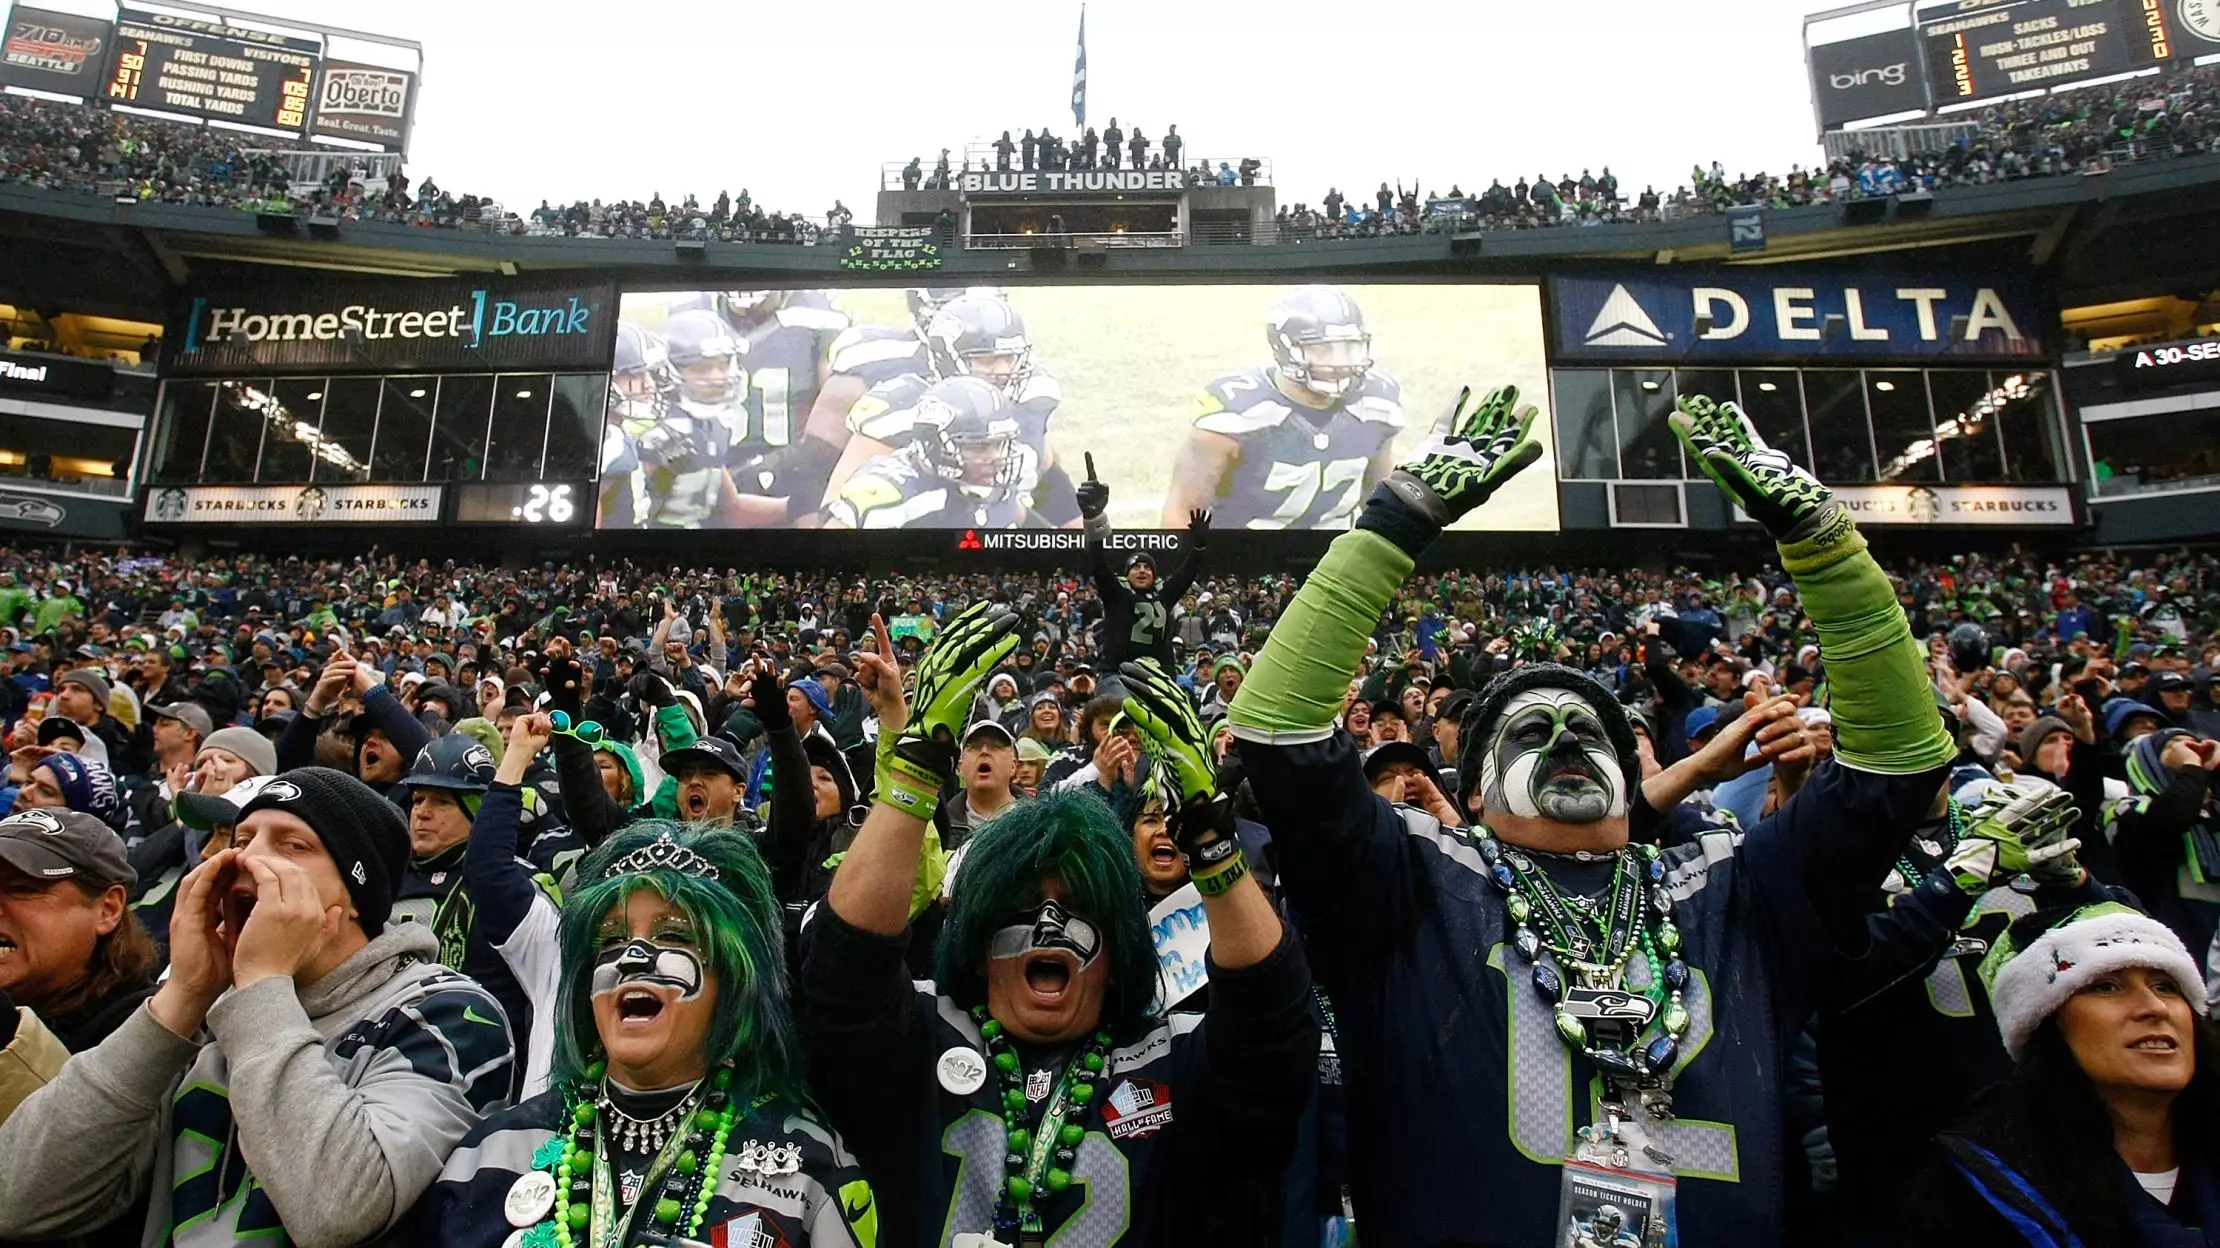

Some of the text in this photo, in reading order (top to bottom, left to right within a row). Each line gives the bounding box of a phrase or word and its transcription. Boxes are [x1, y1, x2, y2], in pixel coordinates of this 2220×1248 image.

[1927, 11, 2010, 37] SEAHAWKS
[2013, 16, 2058, 35] SACKS
[2146, 11, 2161, 26] 2
[118, 26, 193, 47] SEAHAWKS
[152, 14, 287, 44] OFFENSE
[2149, 27, 2165, 43] 3
[136, 40, 148, 56] 7
[1954, 33, 1963, 48] 1
[6, 52, 76, 72] SEATTLE
[121, 53, 145, 71] 50
[173, 48, 254, 73] FIRST DOWNS
[243, 47, 311, 67] VISITORS
[1951, 49, 1966, 64] 2
[1996, 40, 2097, 70] THREE AND OUT
[116, 68, 141, 86] 91
[162, 61, 259, 88] PASSING YARDS
[301, 68, 312, 84] 7
[1829, 62, 1908, 90] bing
[1954, 65, 1970, 80] 2
[2008, 58, 2091, 84] TAKEAWAYS
[158, 76, 257, 103] RUSHING YARDS
[326, 79, 402, 106] Oberto
[1956, 80, 1972, 96] 3
[165, 91, 245, 115] TOTAL YARDS
[964, 170, 1184, 193] BLUE THUNDER
[854, 226, 933, 238] KEEPERS
[848, 245, 863, 257] 12
[862, 238, 924, 248] OF THE
[871, 248, 916, 258] FLAG
[922, 243, 938, 256] 12
[840, 258, 871, 270] MAKE
[872, 259, 903, 270] SOME
[206, 297, 591, 343] HomeStreet Bank
[1691, 286, 2023, 343] DELTA
[2134, 341, 2220, 368] A 30-SE
[984, 533, 1179, 550] MITSUBISHI LECTRIC
[1532, 879, 1565, 921] SEAHAWKS
[1619, 884, 1633, 922] SEAHAWKS
[1029, 1082, 1048, 1097] NFL
[1113, 1121, 1139, 1136] HALL
[1145, 1110, 1172, 1126] FAME
[727, 1169, 813, 1211] SEAHAWKS
[1574, 1185, 1598, 1198] SEASON
[1600, 1191, 1621, 1204] TICKET
[1623, 1196, 1648, 1209] HOLDER
